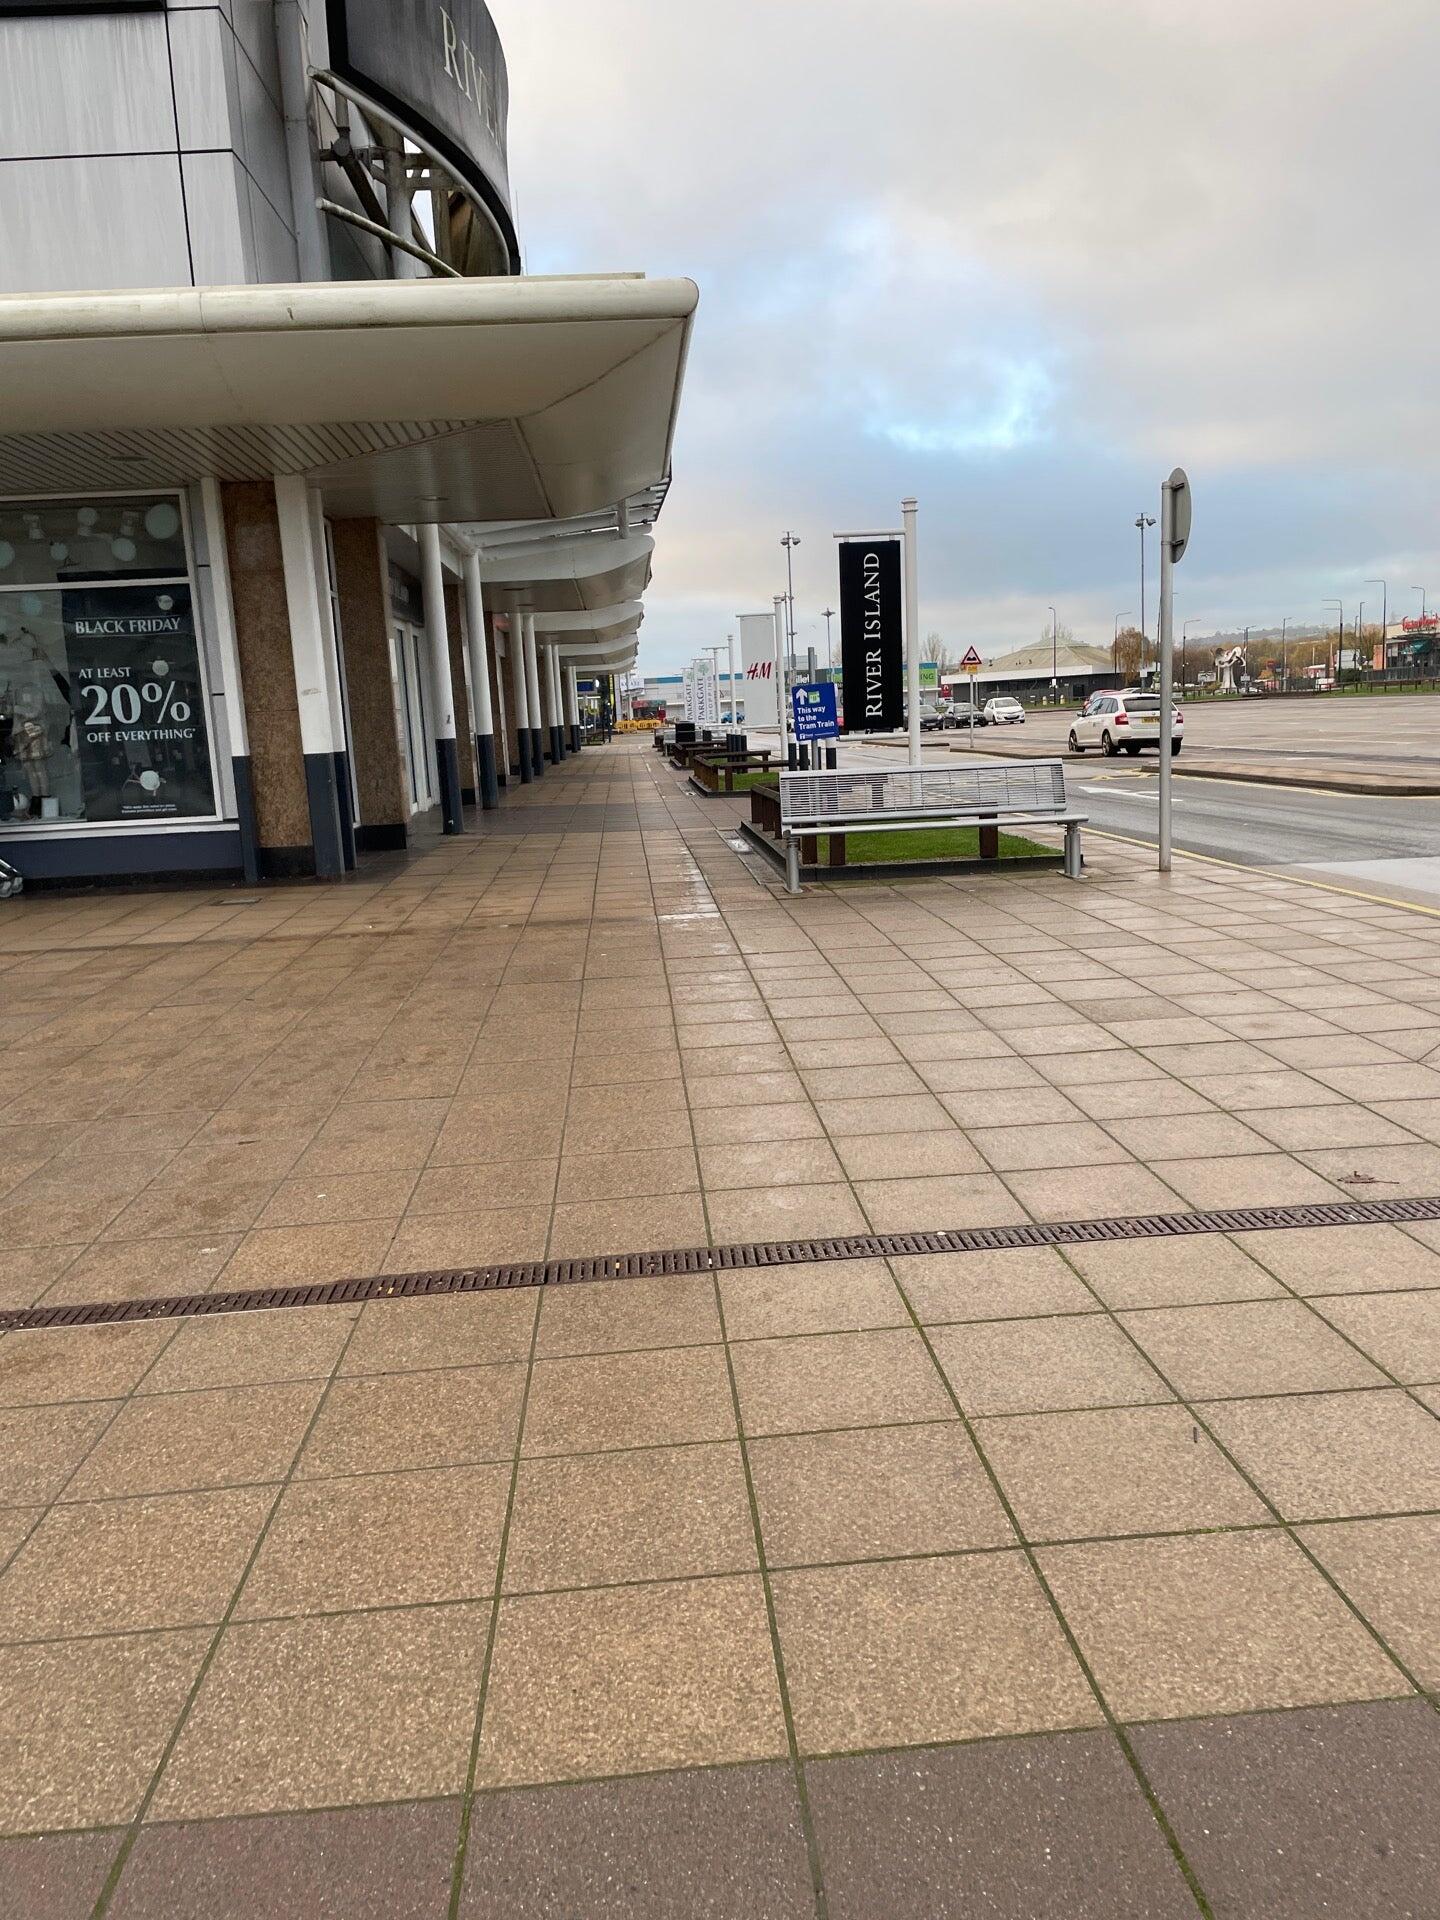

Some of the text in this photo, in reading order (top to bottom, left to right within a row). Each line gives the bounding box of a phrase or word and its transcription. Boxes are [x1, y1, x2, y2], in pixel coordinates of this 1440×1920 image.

[75, 617, 180, 634] BLACK FRIDAY
[863, 552, 883, 718] RIVER ISLAND
[78, 666, 131, 679] AT LEAST
[746, 661, 772, 680] H&M
[81, 680, 191, 725] 20%
[697, 678, 705, 720] PARKGATE
[797, 705, 826, 714] This way
[799, 720, 835, 730] Tram Train
[86, 731, 112, 743] OFF
